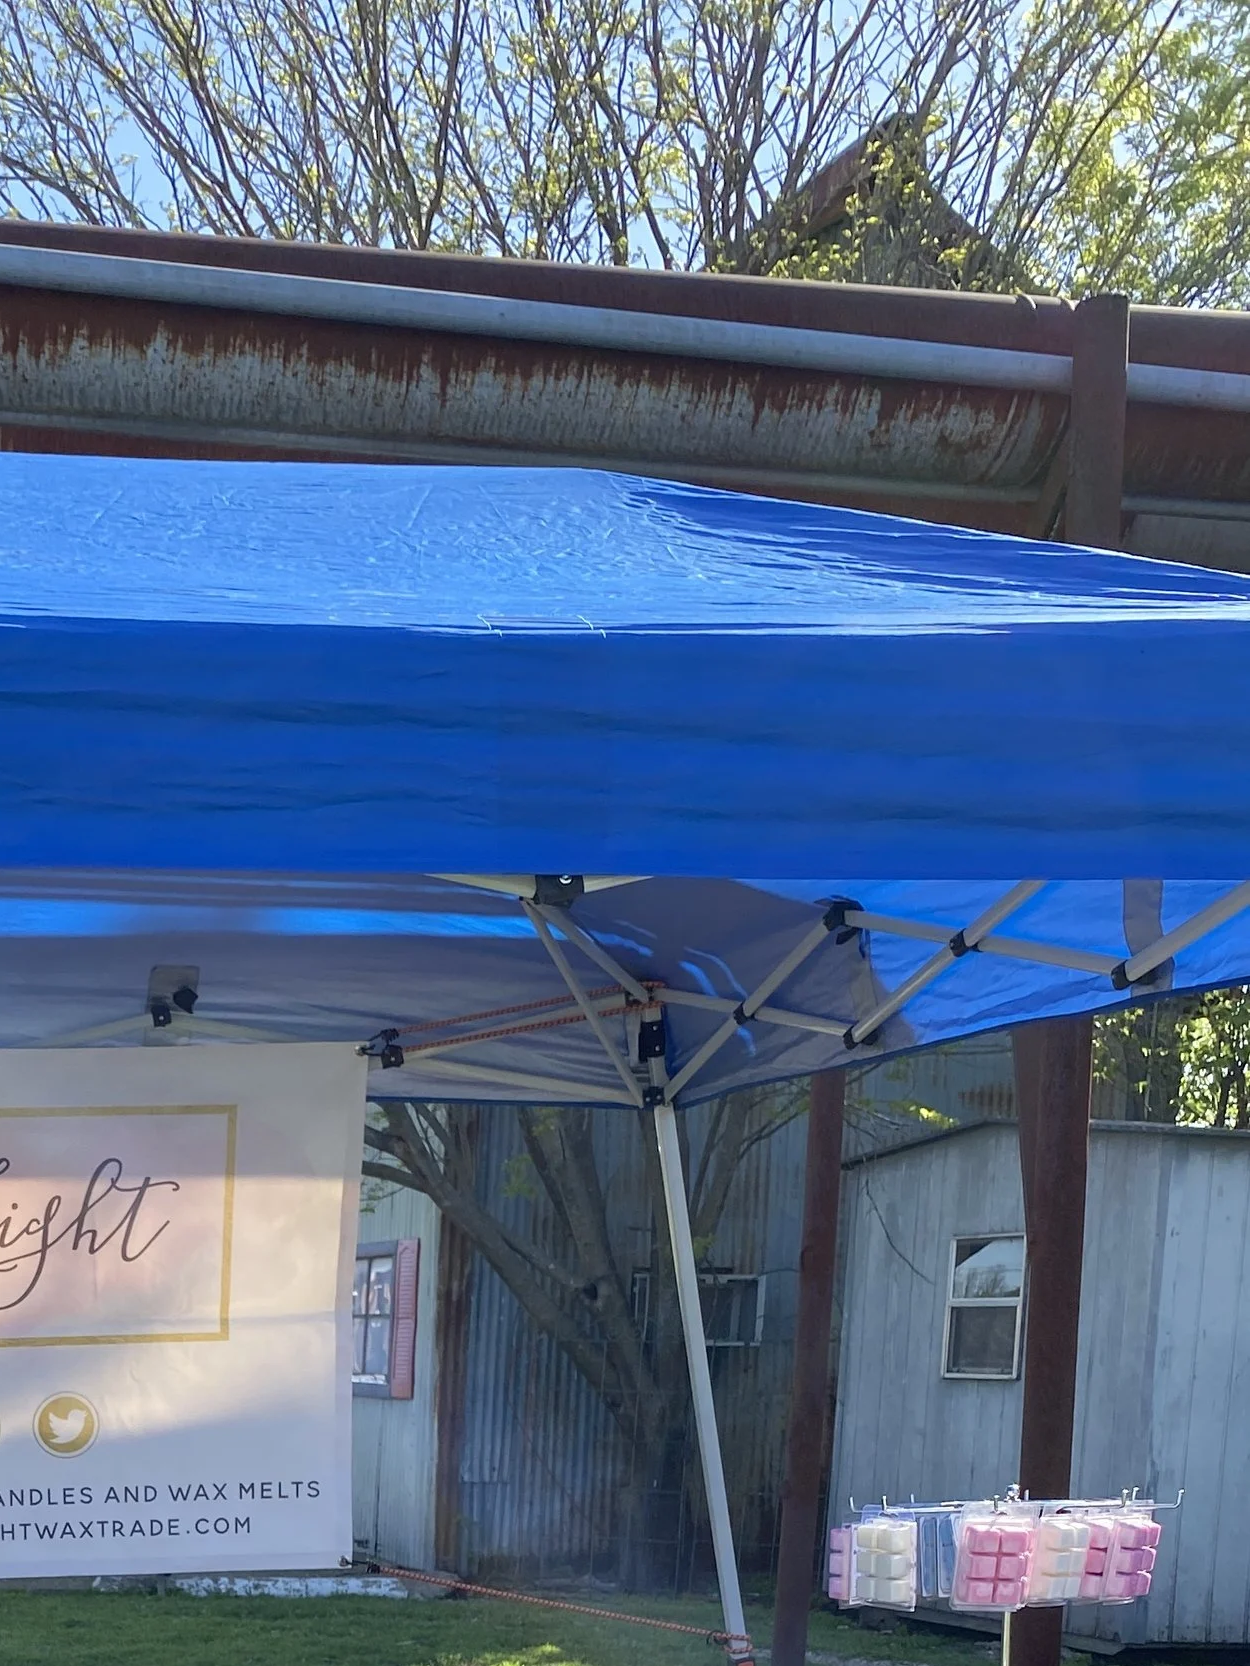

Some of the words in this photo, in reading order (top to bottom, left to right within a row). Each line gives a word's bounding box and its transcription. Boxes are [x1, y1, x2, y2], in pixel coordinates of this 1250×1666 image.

[104, 1485, 158, 1504] AND
[167, 1482, 228, 1502] WAX
[239, 1480, 321, 1500] MELTS
